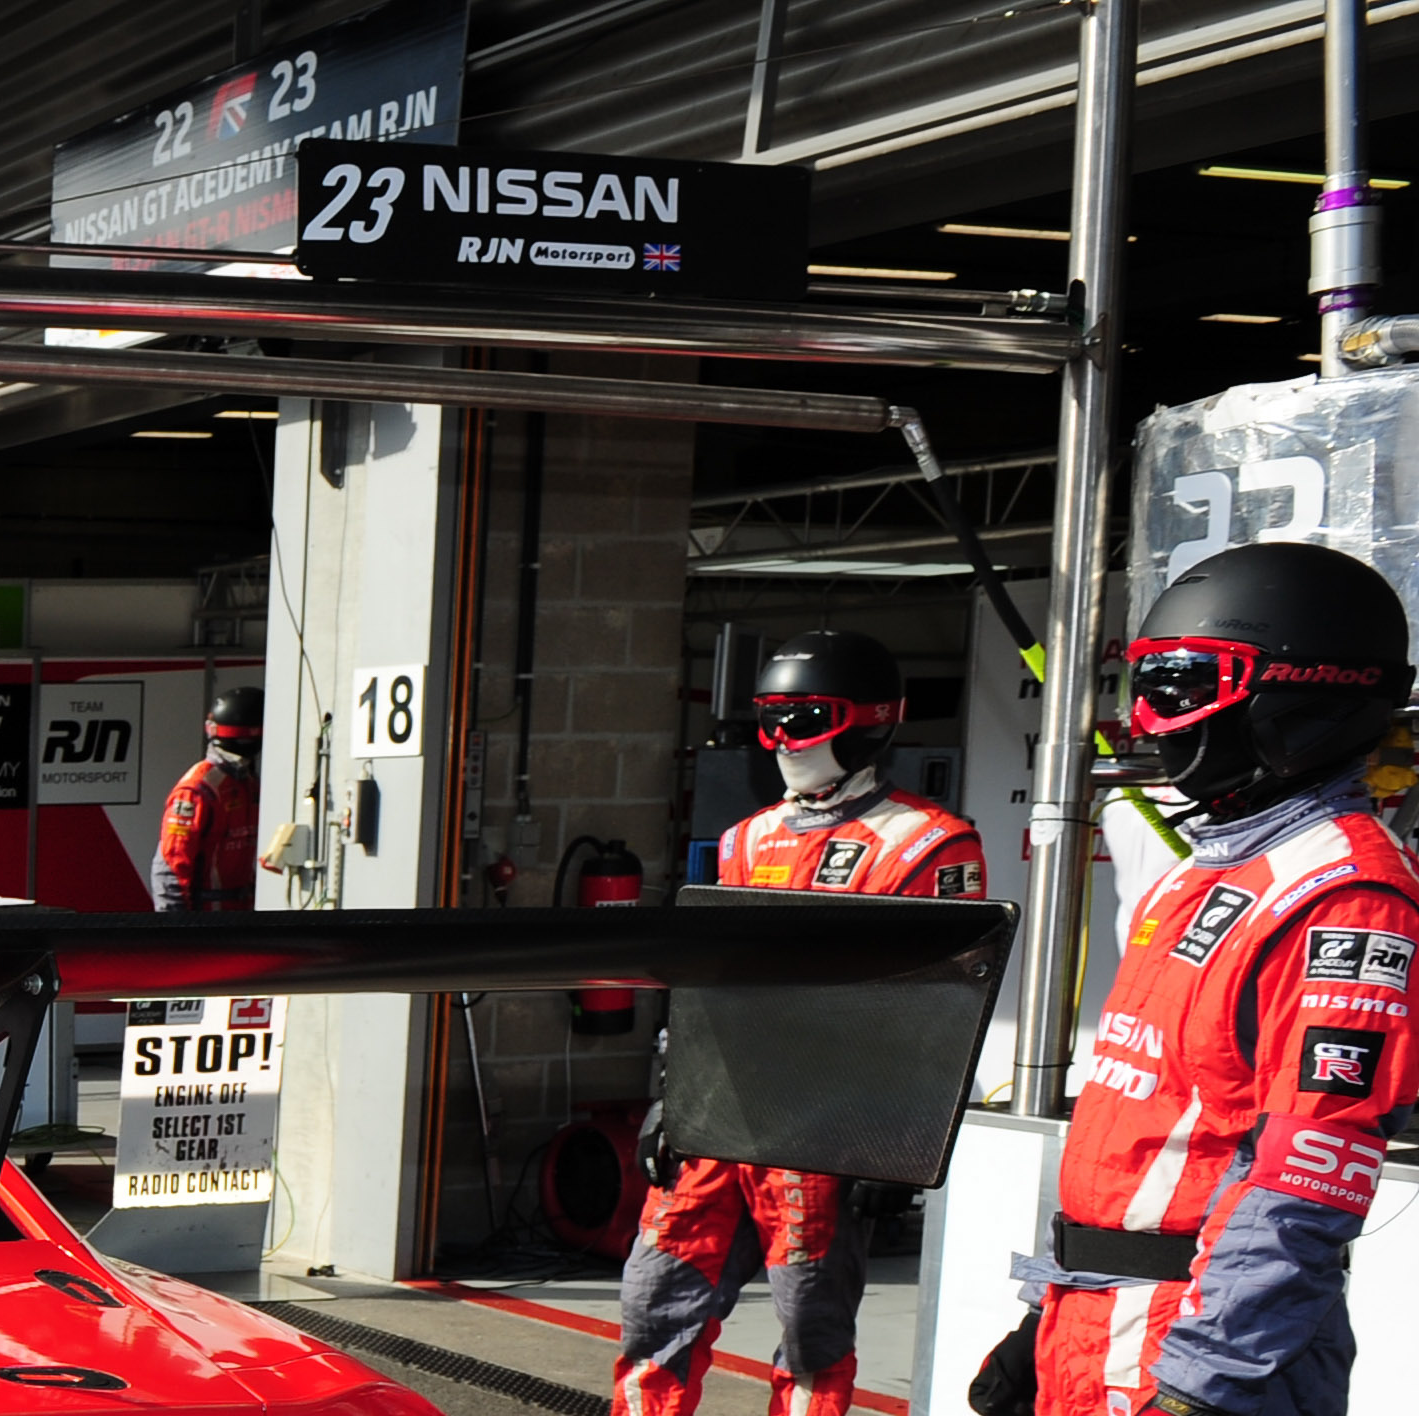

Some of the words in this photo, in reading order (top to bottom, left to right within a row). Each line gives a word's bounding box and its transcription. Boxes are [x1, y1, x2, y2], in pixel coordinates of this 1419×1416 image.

[153, 101, 193, 166] 22
[269, 51, 317, 121] 23
[65, 195, 139, 244] NISSAN
[142, 184, 172, 225] GT
[174, 140, 292, 216] ACEDEMY
[379, 86, 438, 142] RJN
[302, 164, 405, 243] 23
[423, 164, 679, 223] NISSAN
[458, 236, 524, 264] RJN
[534, 246, 631, 265] Motorsport
[70, 701, 103, 713] TEAM
[359, 675, 413, 744] 18
[42, 720, 132, 763] RJN
[42, 772, 127, 785] MOTORSPORT
[1368, 949, 1409, 973] RJN
[1301, 994, 1409, 1018] nismo
[134, 1033, 273, 1076] STOP!
[1313, 1042, 1369, 1060] GT
[1312, 1058, 1365, 1086] R
[154, 1084, 213, 1108] ENGINE
[218, 1082, 247, 1104] OFF
[152, 1114, 211, 1139] SELECT
[216, 1113, 246, 1135] 1ST
[175, 1138, 219, 1161] GEAR
[128, 1173, 180, 1196] RADIO
[187, 1169, 260, 1193] CONTACT
